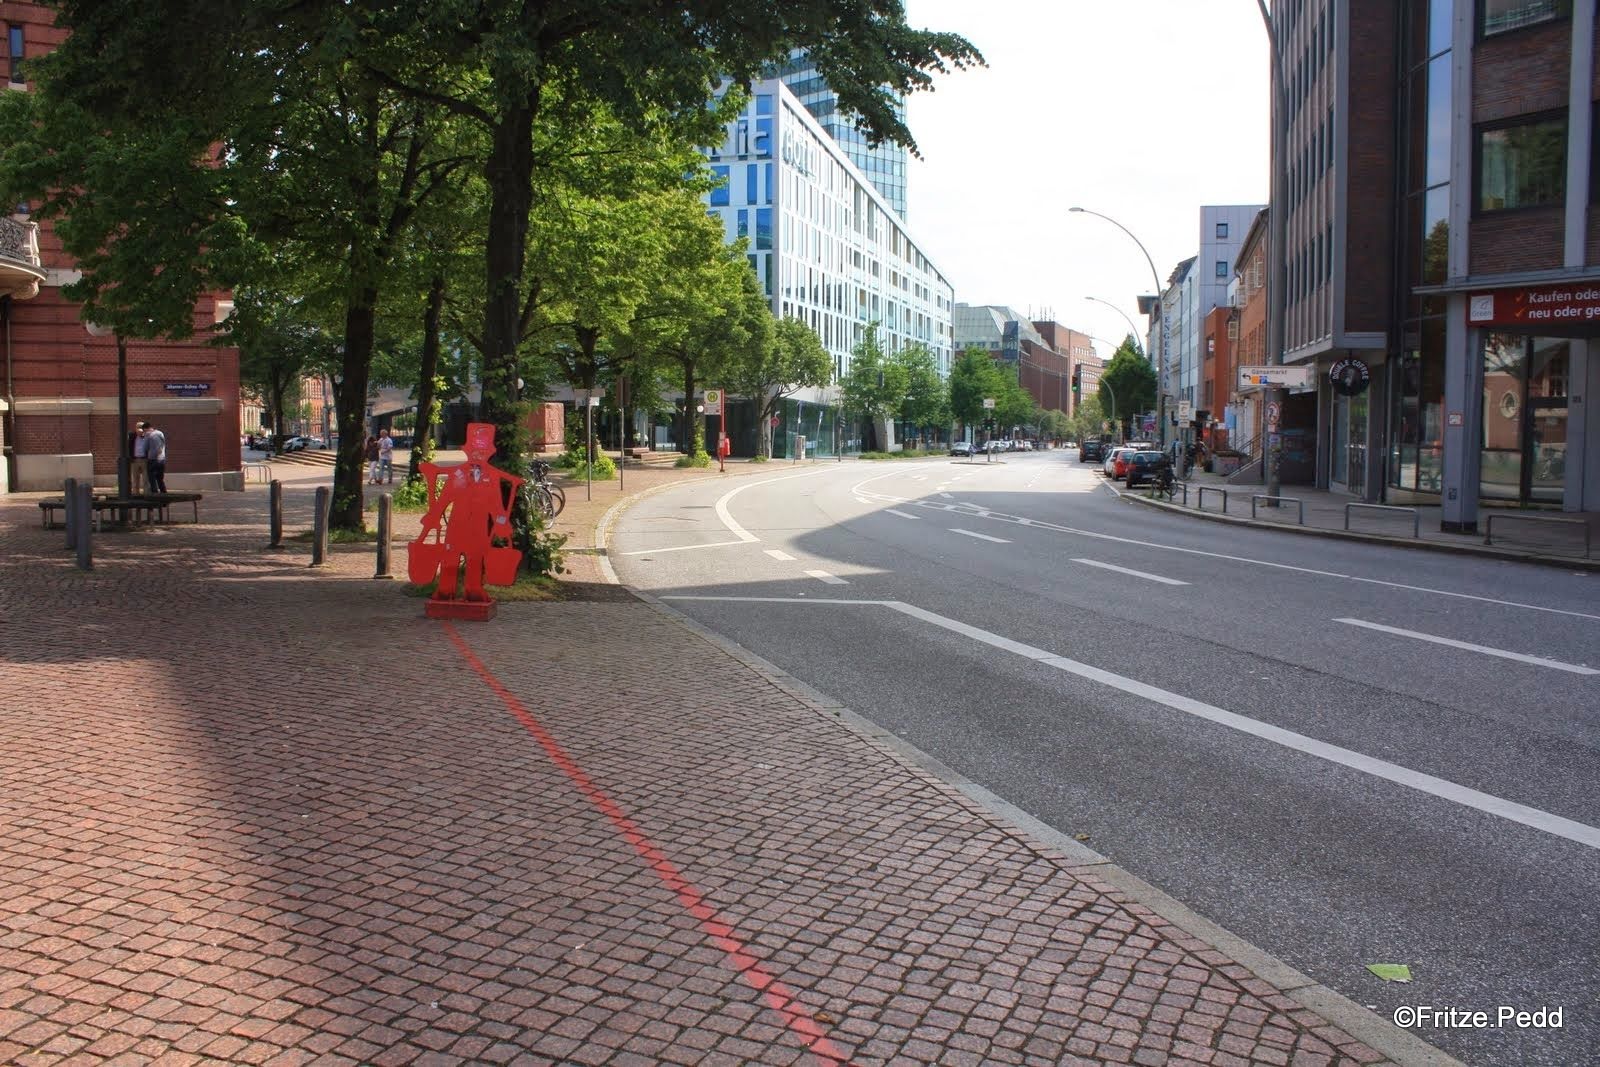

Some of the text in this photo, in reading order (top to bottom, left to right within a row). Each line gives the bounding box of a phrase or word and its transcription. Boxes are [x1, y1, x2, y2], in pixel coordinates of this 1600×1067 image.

[1528, 289, 1600, 303] Kaufen ode
[1528, 309, 1551, 318] neu
[1554, 305, 1583, 317] oder
[1332, 360, 1369, 380] DOUBLE COFFEE
